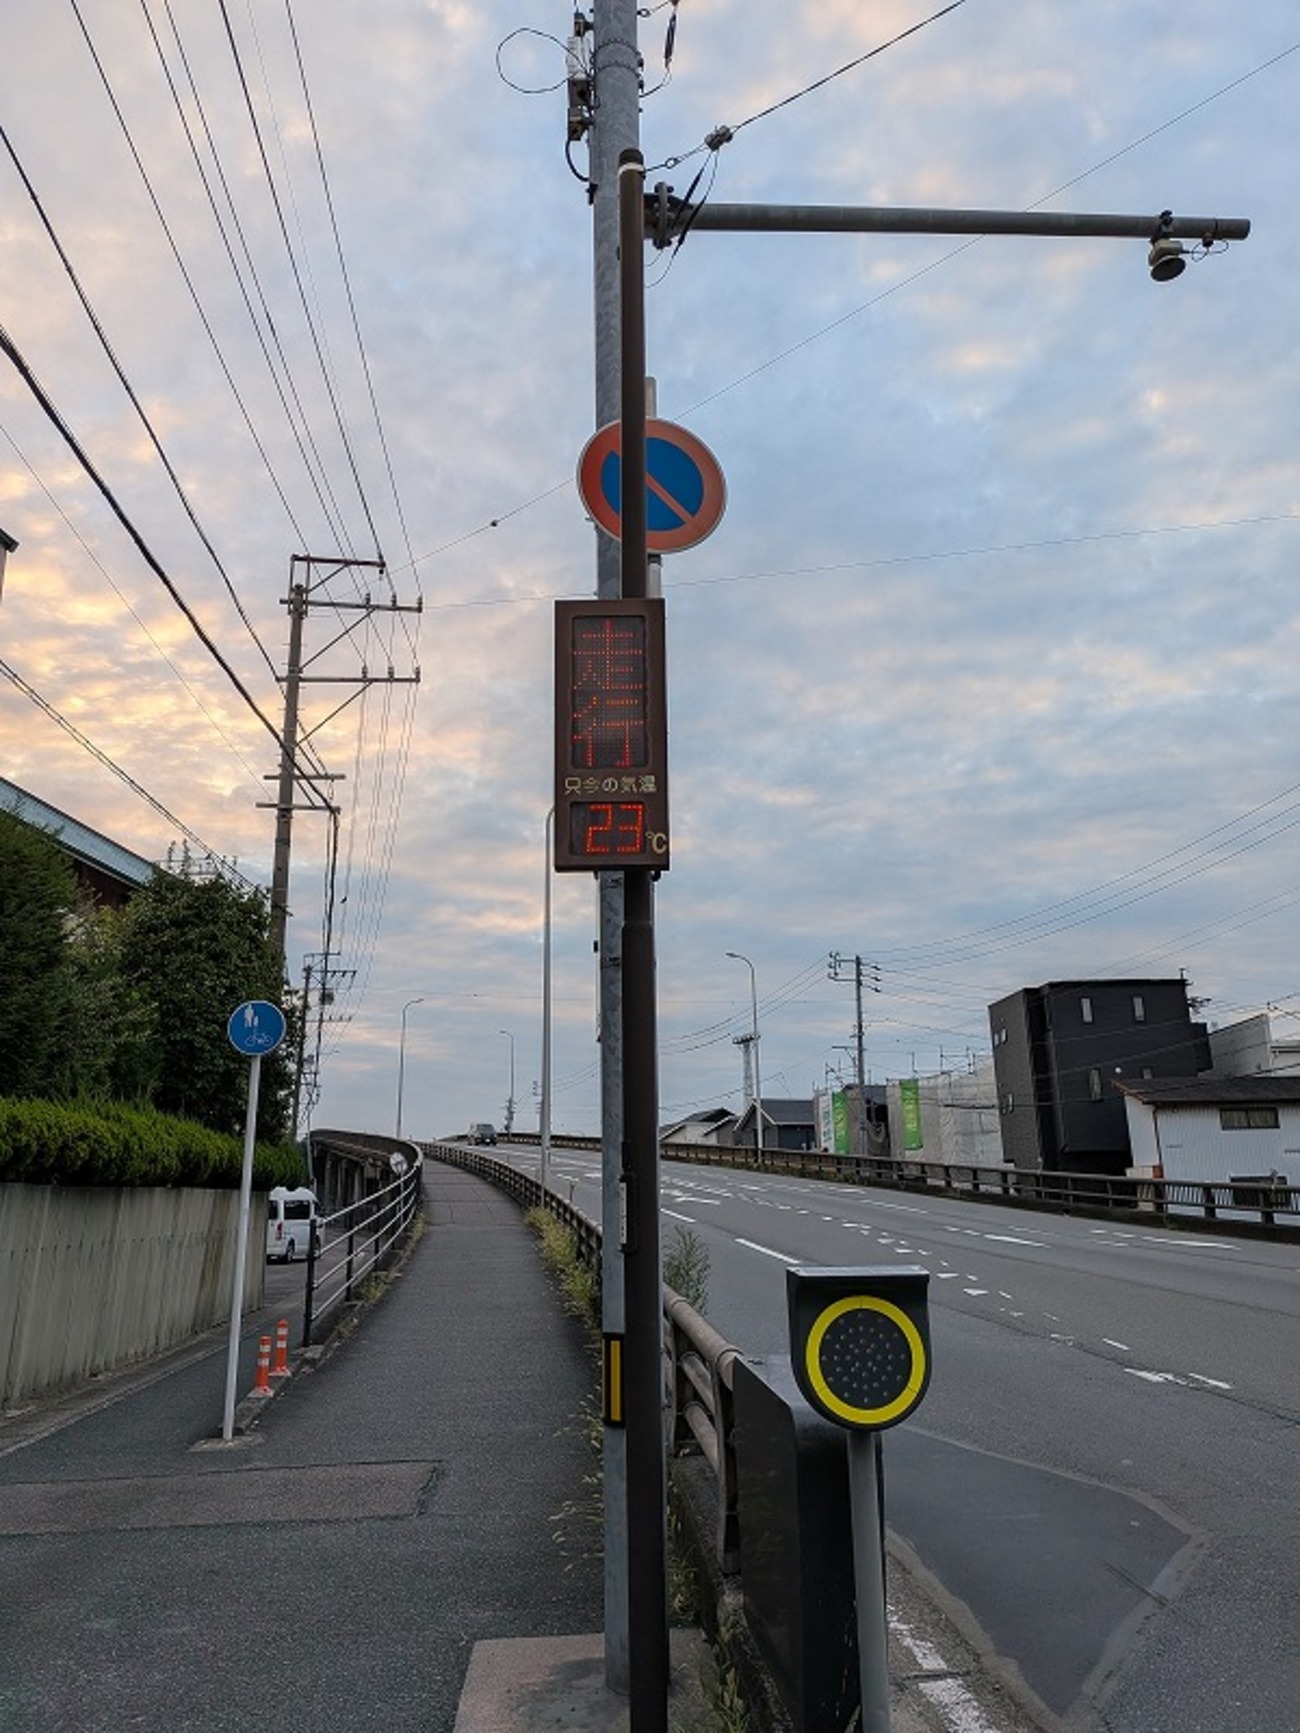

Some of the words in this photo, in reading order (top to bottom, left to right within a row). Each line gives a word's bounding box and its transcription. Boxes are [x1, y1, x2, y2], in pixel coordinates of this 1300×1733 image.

[573, 620, 644, 767] 走行
[564, 775, 657, 796] 只今の気温
[586, 803, 642, 853] 23
